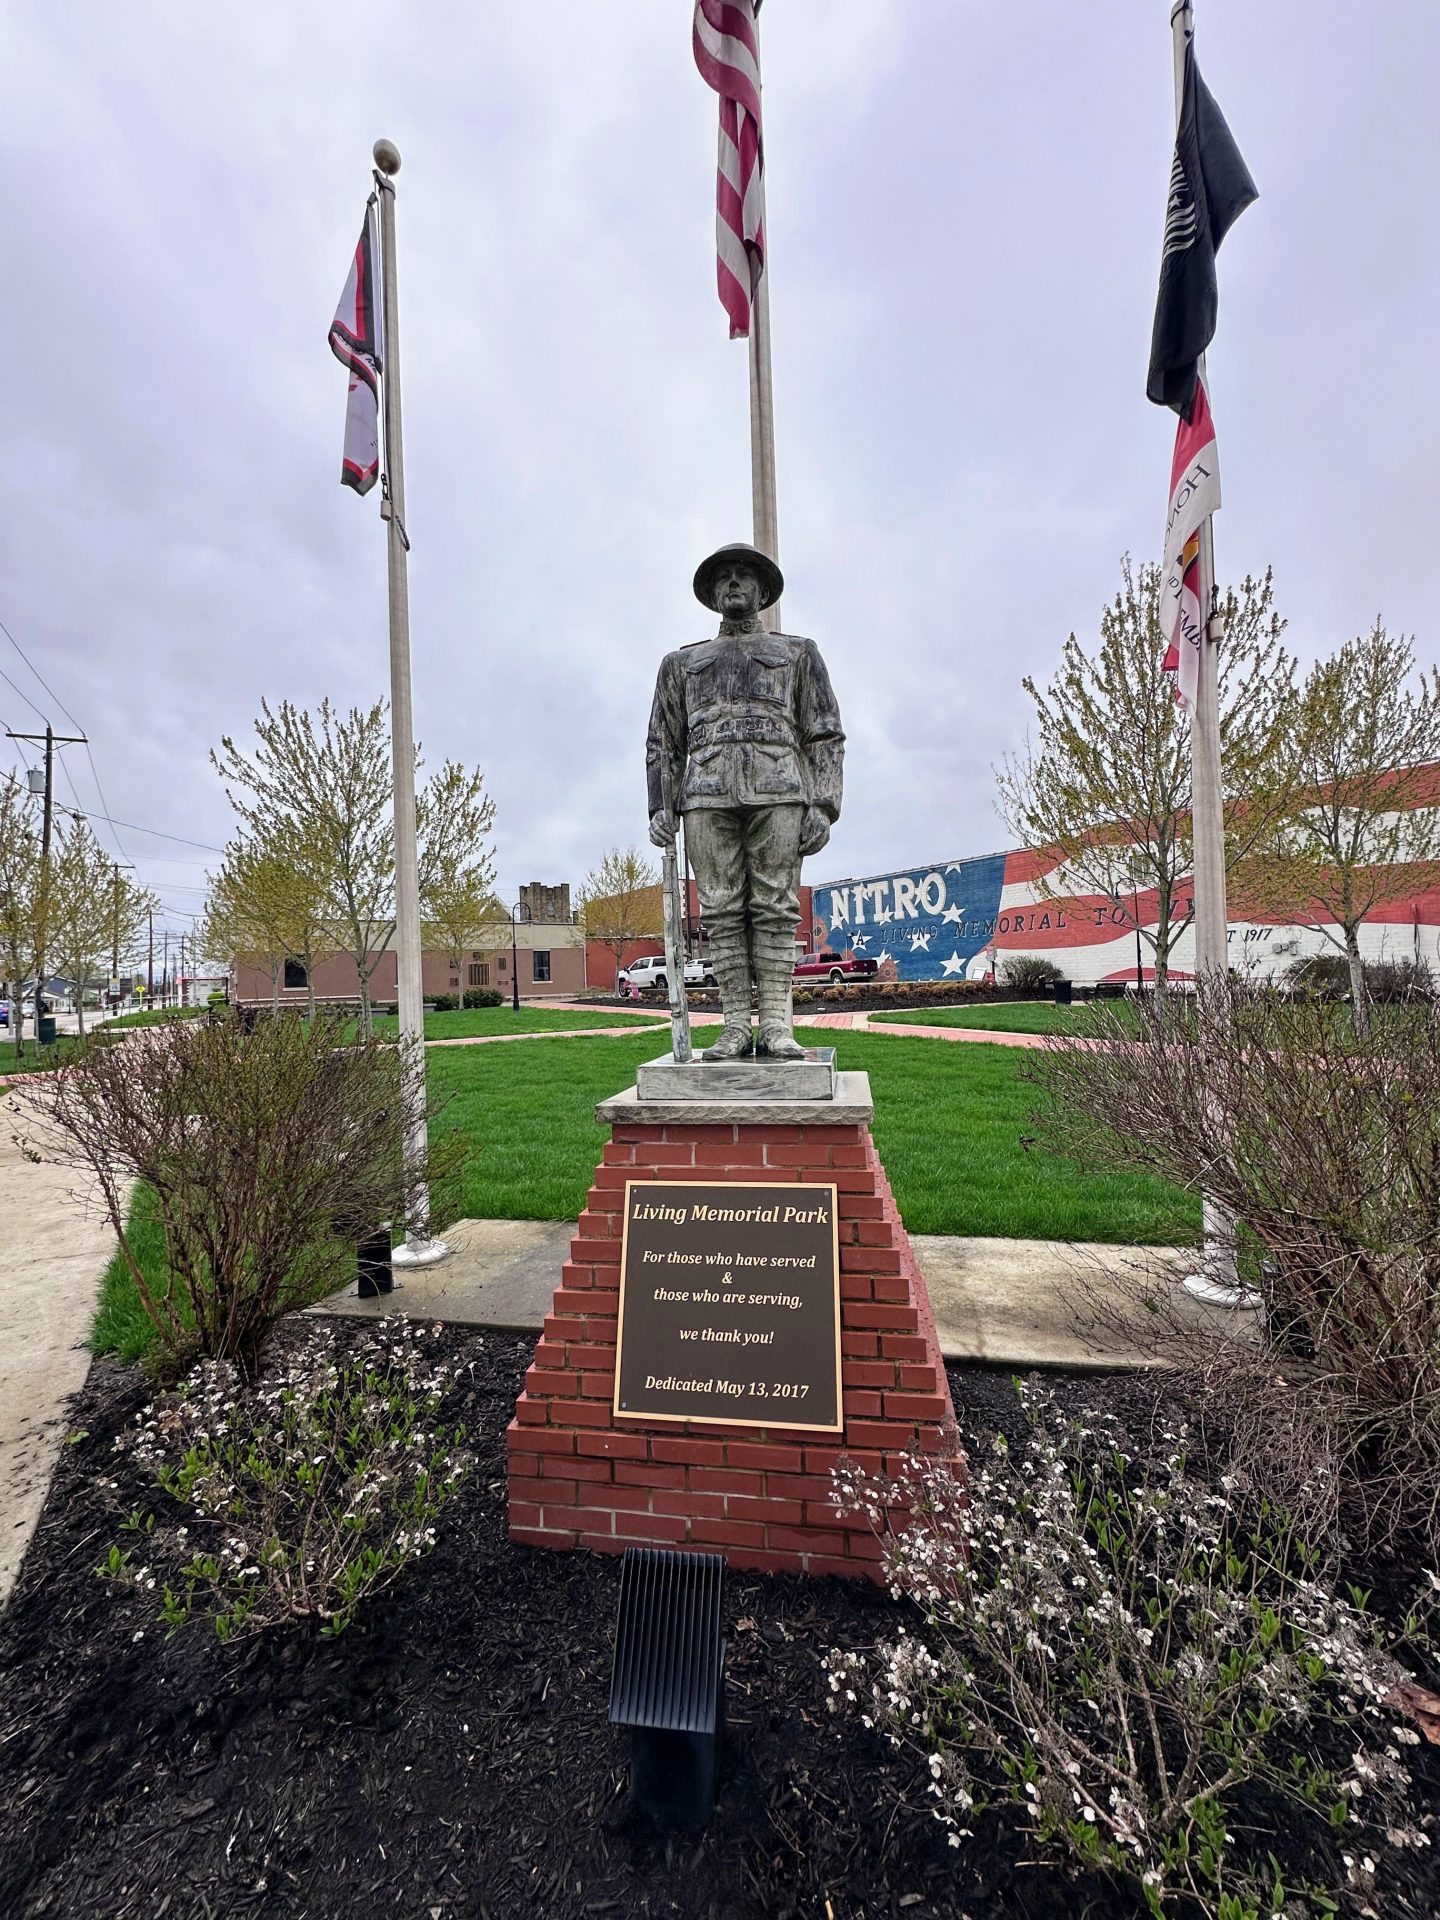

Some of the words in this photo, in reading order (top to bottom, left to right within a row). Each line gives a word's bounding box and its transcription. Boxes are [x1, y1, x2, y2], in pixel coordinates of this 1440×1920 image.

[830, 872, 947, 925] NITRO
[856, 932, 866, 946] A
[880, 925, 938, 945] LIVING
[953, 911, 1067, 938] MEMORIAL
[1094, 906, 1126, 926] TO
[1244, 928, 1273, 942] 1917
[632, 1203, 687, 1225] Living
[691, 1204, 779, 1223] Memorial
[783, 1207, 829, 1224] Park
[642, 1250, 665, 1264] For
[667, 1251, 702, 1265] those
[705, 1252, 733, 1266] who
[735, 1253, 767, 1267] have
[770, 1255, 816, 1268] served
[722, 1271, 733, 1284] &
[653, 1288, 689, 1301] those
[692, 1289, 720, 1303] who
[722, 1293, 746, 1304] are
[748, 1292, 804, 1309] serving,
[679, 1330, 699, 1341] we
[701, 1328, 741, 1343] thank
[741, 1331, 775, 1346] you!
[645, 1375, 713, 1393] Dedicated
[715, 1380, 745, 1398] May
[748, 1382, 770, 1398] 13,
[772, 1383, 809, 1399] 2017
